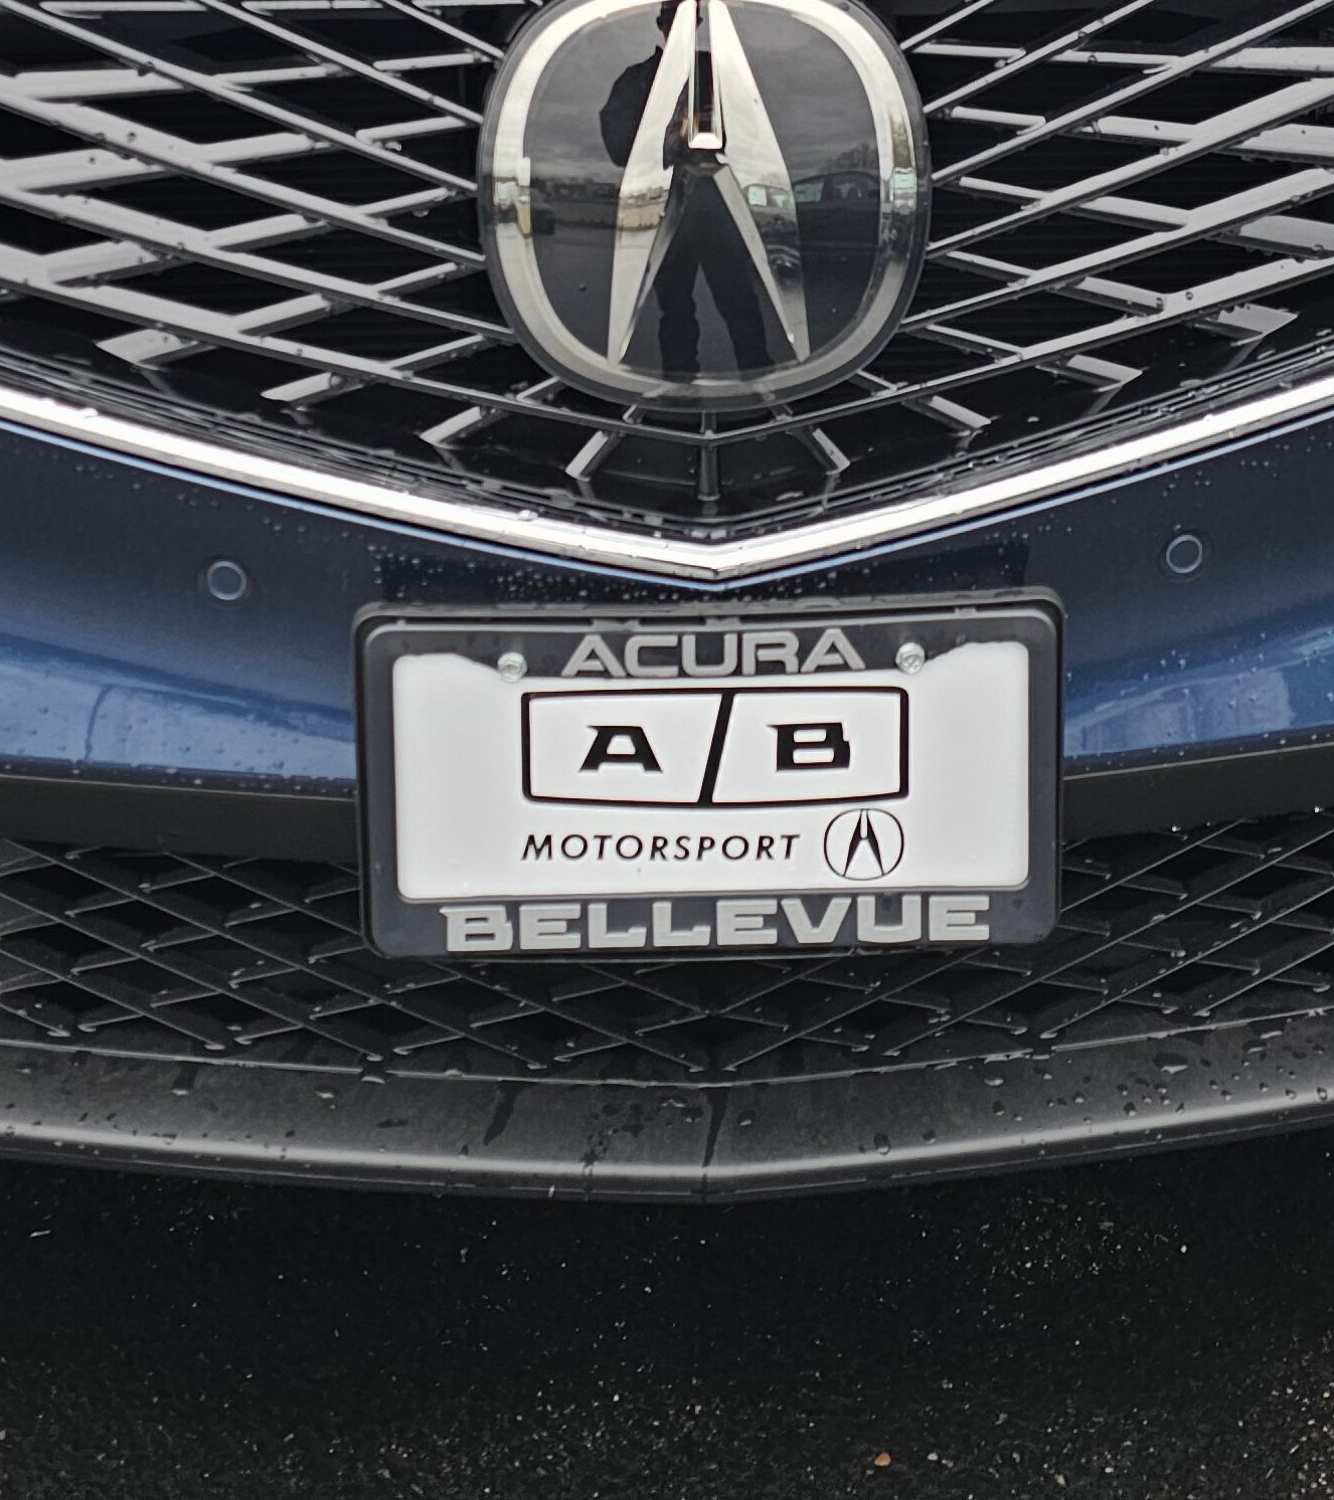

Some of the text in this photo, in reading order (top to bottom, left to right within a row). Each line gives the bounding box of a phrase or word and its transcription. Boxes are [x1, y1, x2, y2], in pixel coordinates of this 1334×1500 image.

[561, 627, 866, 679] ACURA
[522, 833, 801, 861] MOTORSPORT
[438, 894, 991, 952] BELLEVUE
